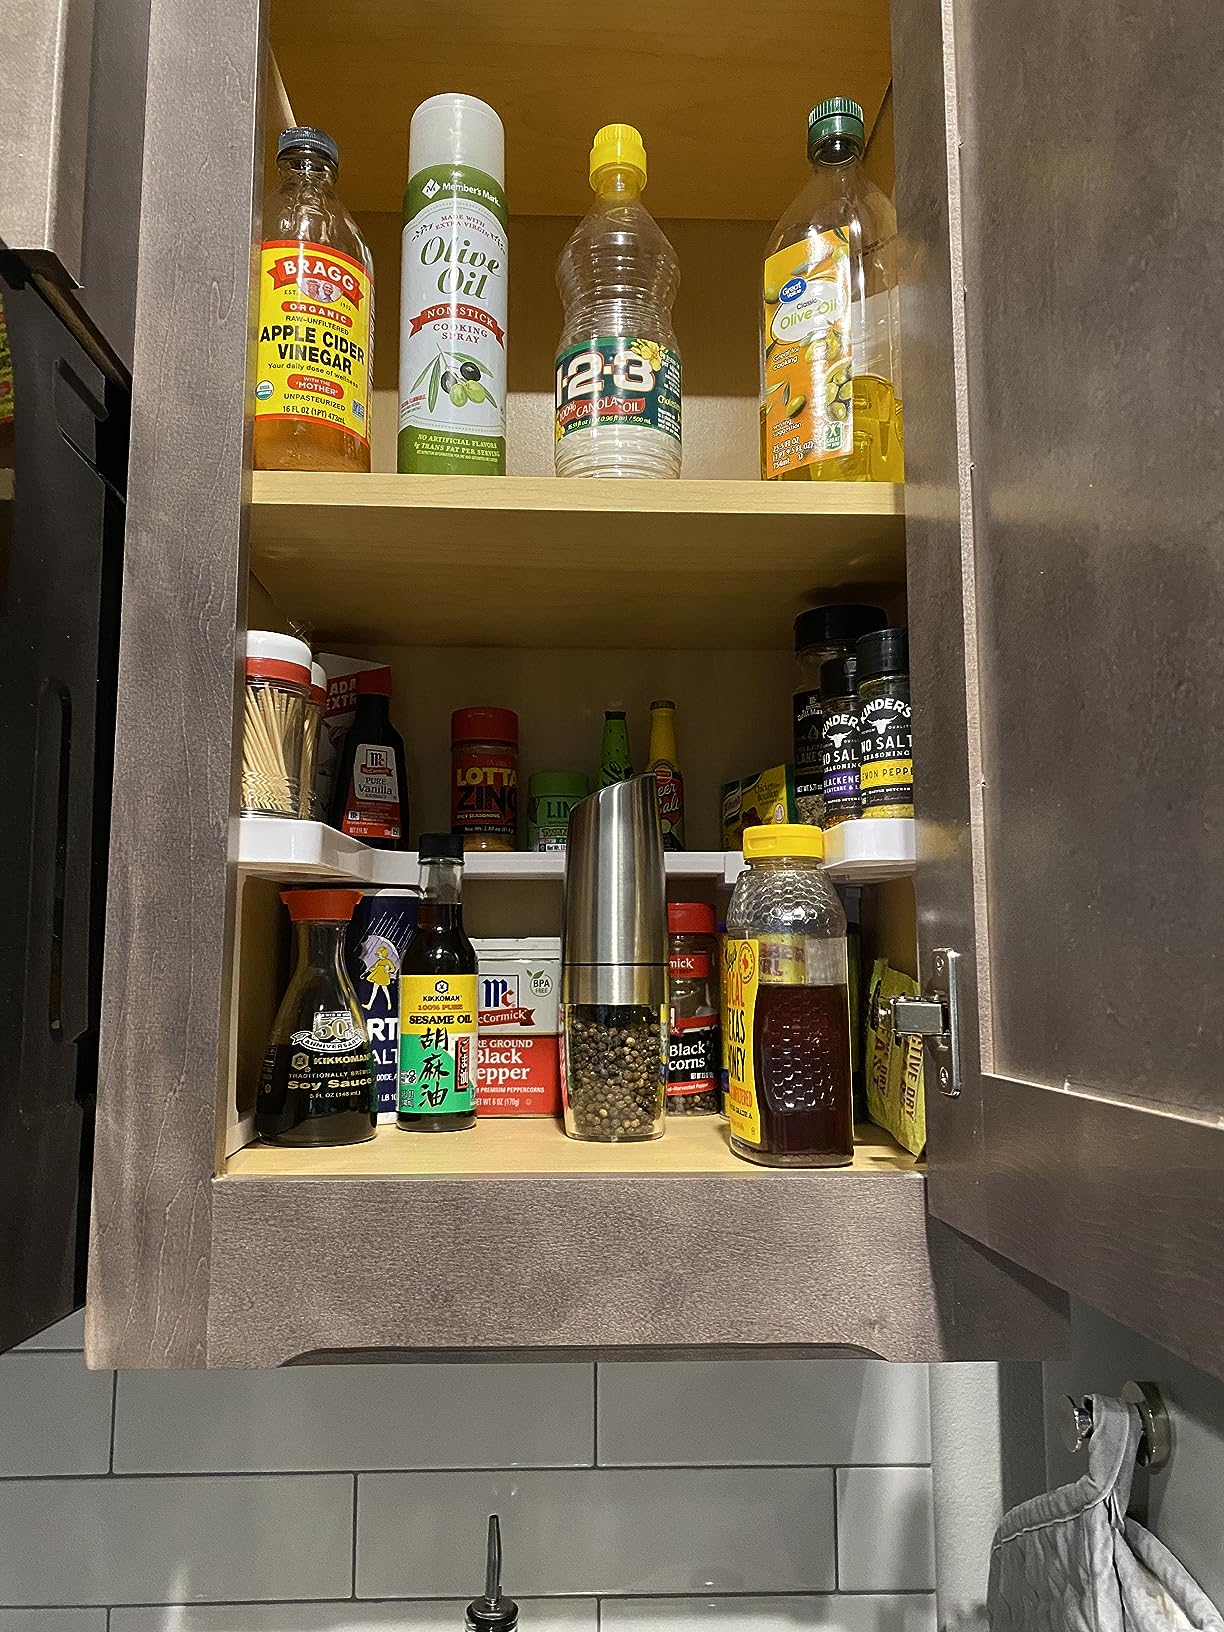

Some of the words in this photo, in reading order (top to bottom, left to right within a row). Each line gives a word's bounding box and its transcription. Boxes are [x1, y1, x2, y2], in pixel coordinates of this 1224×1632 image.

[442, 182, 482, 196] Member's
[466, 215, 486, 228] WITH
[464, 222, 490, 238] VIRGIN
[420, 236, 501, 278] Olive
[282, 259, 355, 291] BRAGG
[437, 266, 488, 299] Oil
[796, 298, 818, 310] Classic
[289, 304, 347, 323] ORGANIC
[780, 309, 813, 330] Olive
[817, 299, 837, 315] Oil
[260, 325, 317, 344] APPLE
[322, 331, 365, 365] CIDER
[278, 343, 352, 375] VINEGAR
[772, 355, 798, 371] cooking
[286, 363, 304, 371] daily
[306, 364, 325, 374] dose
[334, 373, 359, 389] wellness
[282, 405, 291, 413] 16
[292, 406, 299, 414] FL
[284, 393, 346, 411] UNPASTEURIZED
[576, 396, 618, 418] CANOLA
[622, 401, 641, 413] OIL
[428, 435, 470, 446] ARTIFICIAL
[472, 440, 497, 449] FLAVORS
[421, 443, 444, 451] TRANS
[446, 445, 460, 453] FAT
[461, 447, 476, 455] PER
[477, 449, 500, 458] SERVING
[810, 708, 823, 716] Mat
[860, 698, 912, 725] KINDER'S
[822, 714, 860, 738] KINDER
[861, 741, 872, 754] NO
[876, 734, 912, 750] SALT
[833, 748, 859, 763] SAL
[863, 750, 910, 762] SEASONING
[366, 777, 386, 785] PURE
[456, 767, 518, 787] LOTTA
[823, 774, 860, 788] BLACKENE
[862, 769, 879, 781] EMON
[882, 767, 913, 777] PEPP
[358, 783, 393, 795] Vanilla
[657, 784, 678, 797] eer
[547, 801, 576, 818] LIM
[541, 828, 568, 838] TWAN
[669, 958, 694, 969] mick
[533, 979, 550, 988] BPA
[442, 1003, 463, 1011] PURE
[409, 1014, 454, 1025] SESAME
[457, 1014, 473, 1024] OIL
[478, 1009, 527, 1024] cCormick
[367, 1018, 399, 1042] RT
[728, 1008, 746, 1045] EXAS
[478, 1040, 487, 1048] RE
[489, 1039, 533, 1048] GROUND
[669, 1041, 706, 1057] Black
[313, 1053, 370, 1065] KIKKOMAN
[371, 1048, 398, 1065] ALT
[477, 1048, 523, 1064] Black
[907, 1034, 923, 1082] CTIVE
[419, 1027, 451, 1108] 胡麻油
[668, 1057, 706, 1071] corns
[288, 1071, 348, 1079] TRADITIONALLY
[477, 1067, 531, 1085] epper
[287, 1081, 322, 1091] Soy
[328, 1078, 372, 1089] Sauce
[381, 1093, 390, 1101] LB
[483, 1098, 491, 1106] WT
[496, 1098, 503, 1106] OZ
[905, 1087, 916, 1121] DRY
